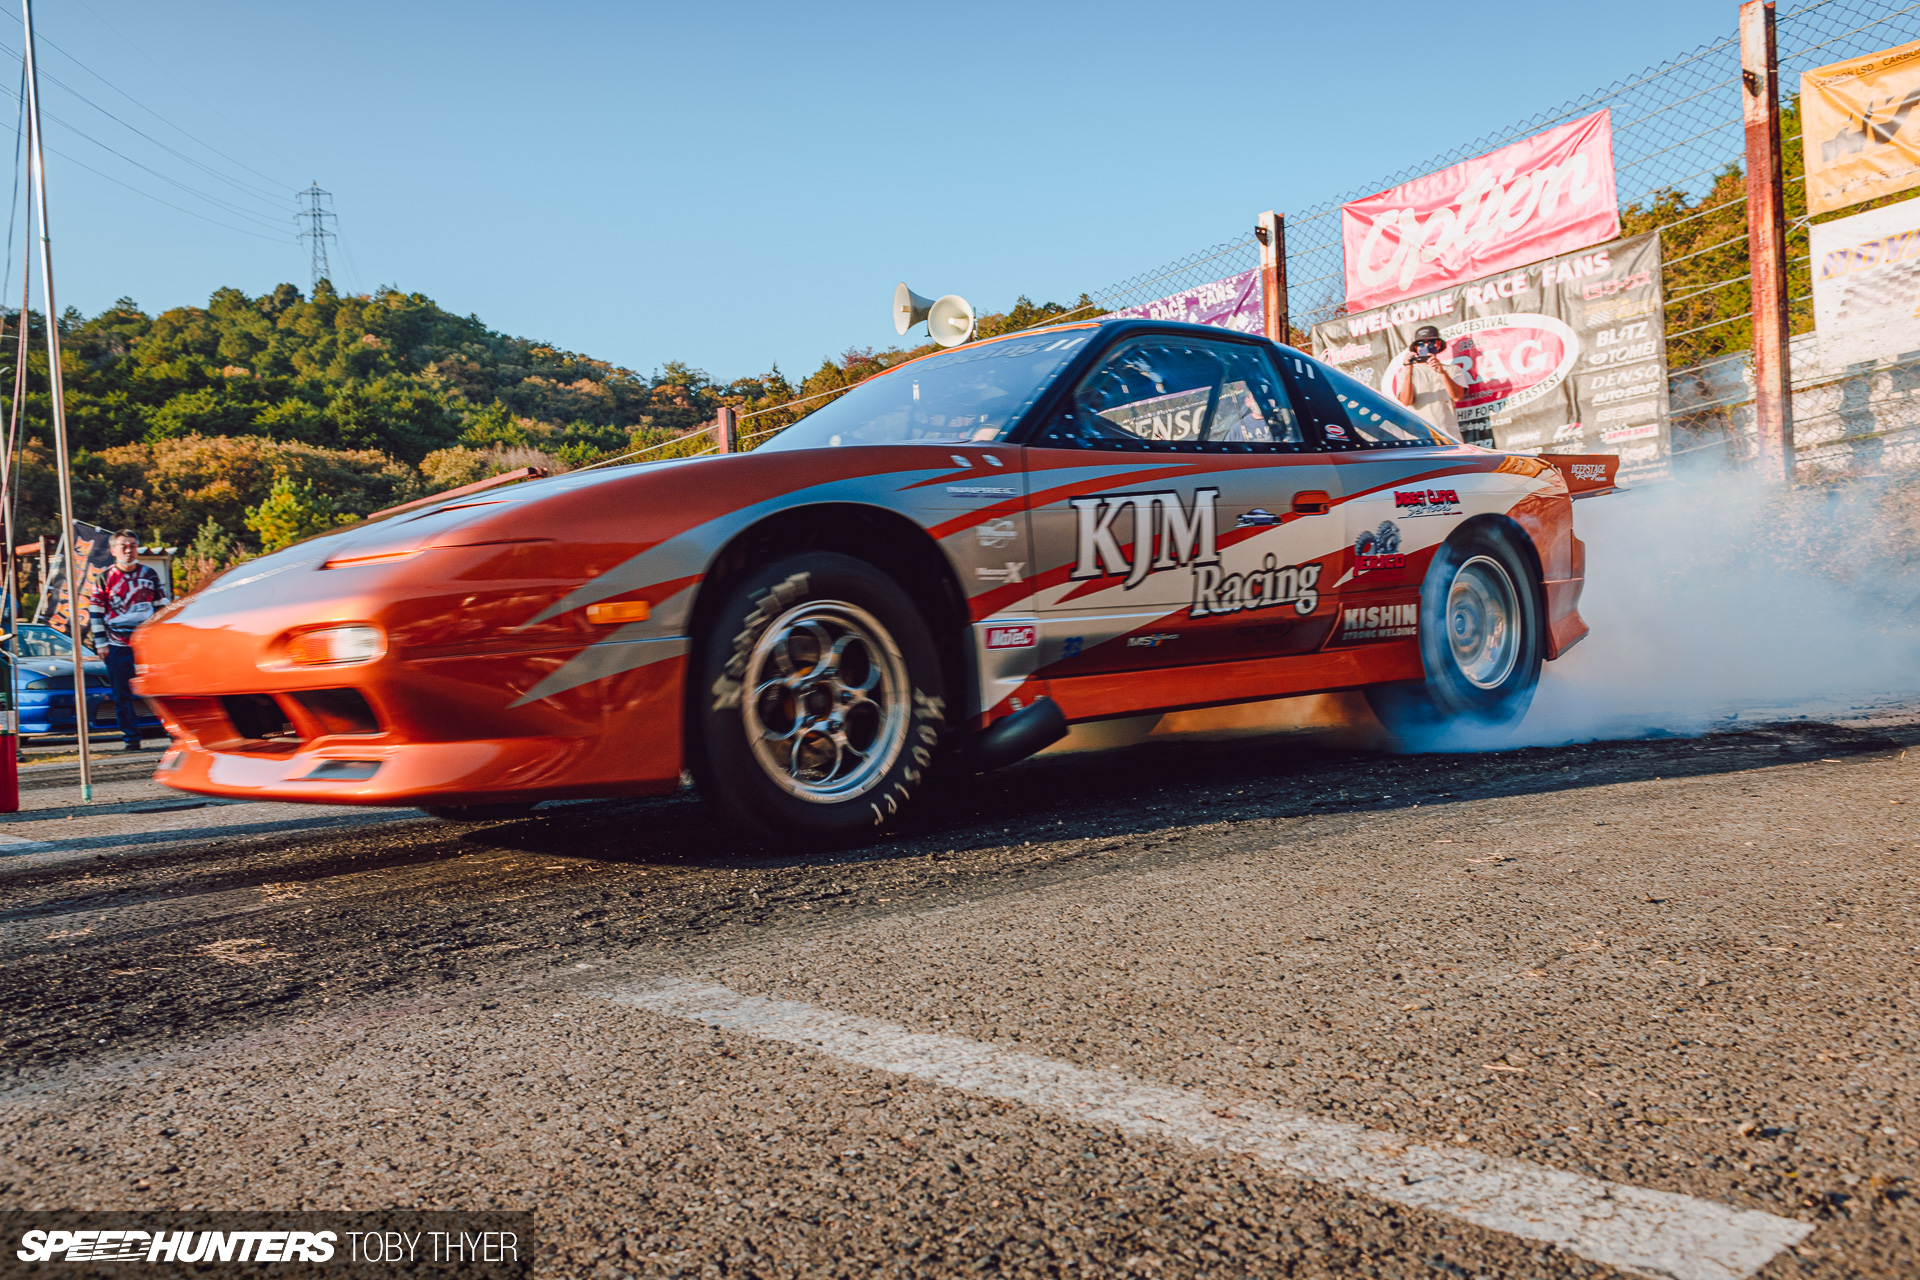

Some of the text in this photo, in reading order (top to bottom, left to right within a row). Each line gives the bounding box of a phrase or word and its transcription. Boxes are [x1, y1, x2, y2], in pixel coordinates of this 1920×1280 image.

[1855, 63, 1875, 76] LSD
[1357, 152, 1599, 292] Option
[1150, 282, 1238, 321] RACE FANS
[1347, 250, 1612, 338] WELCOME RACE FANS
[1463, 316, 1510, 333] FESTIVAL
[1596, 320, 1649, 348] BLITZ
[1590, 364, 1661, 390] DENSO
[1474, 403, 1495, 418] FOR
[1518, 372, 1560, 402] FASTEST
[1571, 464, 1607, 474] DEEPSTAGE
[1394, 491, 1427, 508] DIRECT
[1069, 486, 1222, 591] KJM
[1352, 553, 1407, 578] JERICO
[1188, 552, 1324, 619] Racing
[1343, 603, 1418, 631] KISHIN
[1342, 626, 1418, 640] STRONG WELDING
